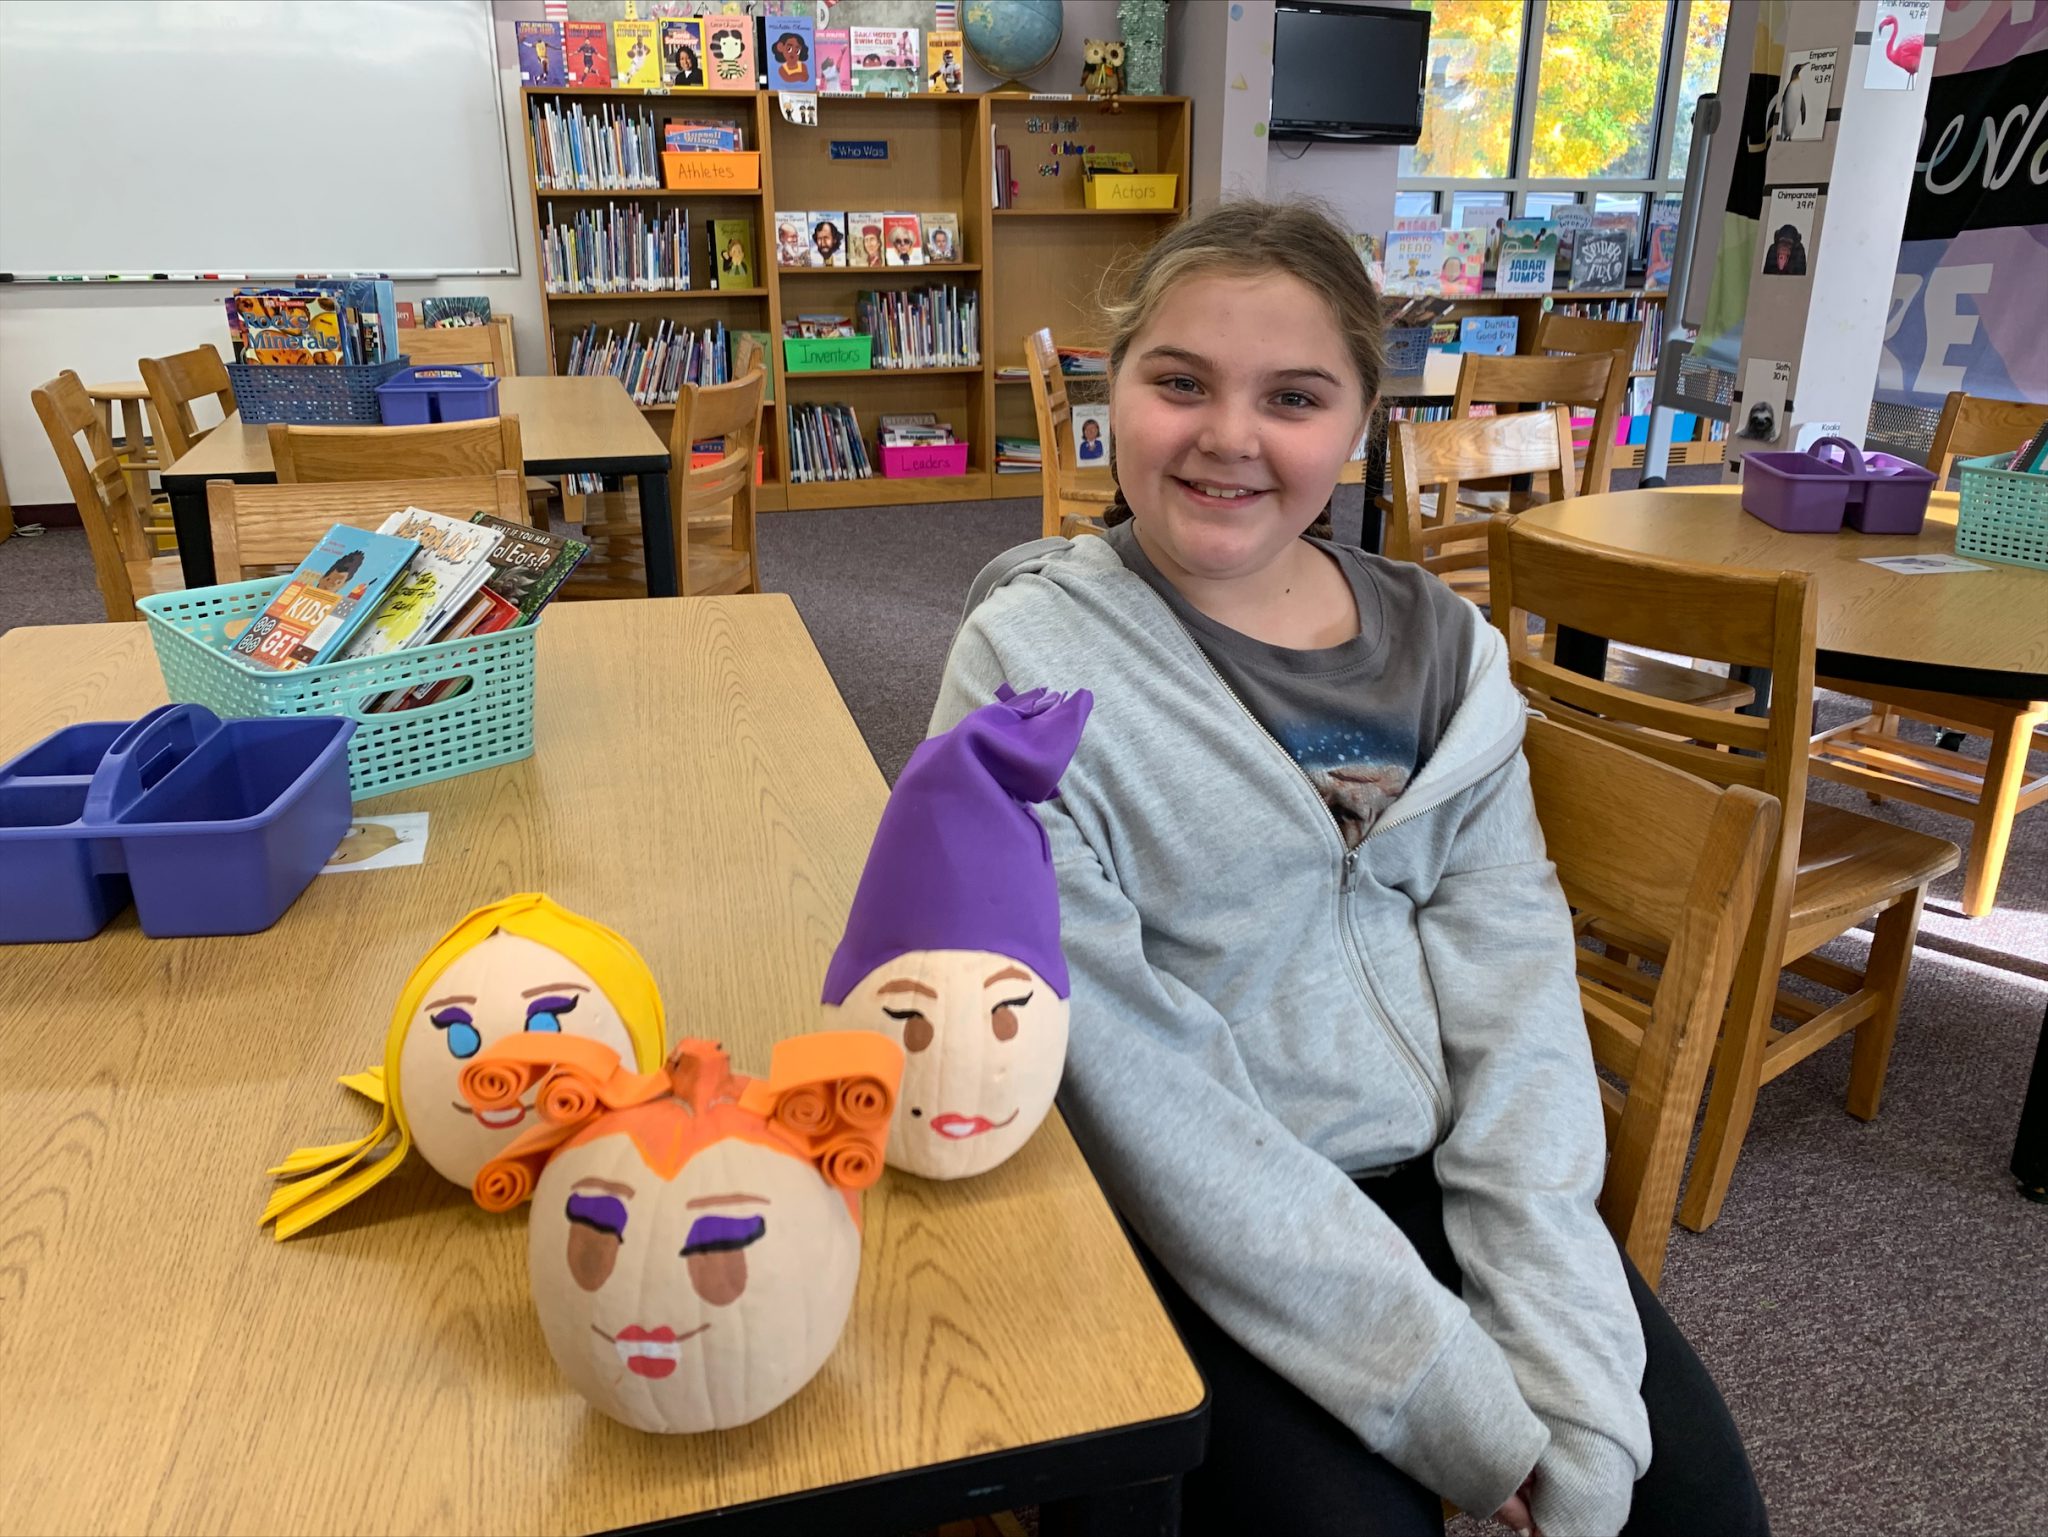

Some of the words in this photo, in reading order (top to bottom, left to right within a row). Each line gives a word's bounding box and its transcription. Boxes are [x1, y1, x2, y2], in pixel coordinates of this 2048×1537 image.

[1809, 51, 1837, 61] Emperor
[1810, 63, 1835, 73] Penguin
[839, 145, 861, 157] Who
[863, 145, 884, 157] Was
[678, 164, 735, 180] Athletes
[1111, 184, 1156, 200] Actors
[1777, 191, 1817, 200] Chimpanzee
[1399, 243, 1433, 253] READ
[1582, 240, 1622, 263] SPIDER
[1509, 259, 1546, 272] JABARI
[1507, 271, 1545, 283] JUMPS
[242, 310, 309, 329] Rocks
[247, 331, 338, 350] Minerals
[1476, 330, 1498, 341] Good
[1500, 329, 1515, 341] Day
[799, 343, 861, 364] Inventors
[1775, 362, 1791, 371] Sloth
[1821, 423, 1840, 431] Koala
[901, 454, 951, 472] Leaders
[511, 528, 519, 537] IF
[519, 531, 535, 542] YOU
[534, 535, 551, 546] HAD
[285, 596, 332, 626] KIDS
[261, 630, 301, 660] GET
